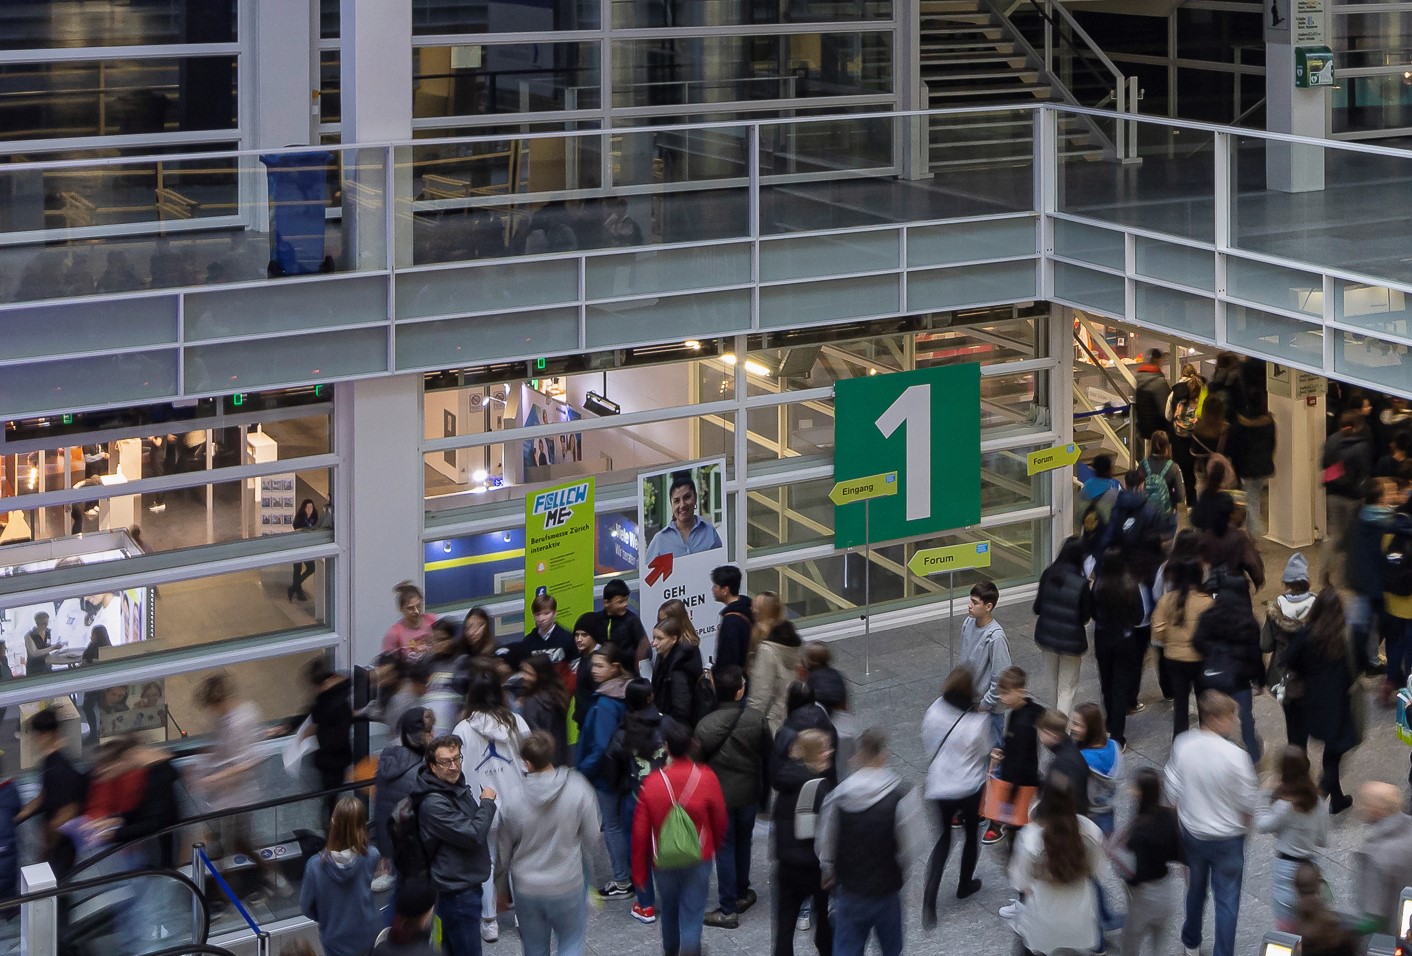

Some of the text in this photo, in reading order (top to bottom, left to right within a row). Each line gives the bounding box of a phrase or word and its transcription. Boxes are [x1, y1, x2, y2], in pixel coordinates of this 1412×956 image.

[874, 384, 931, 521] 1
[1033, 453, 1054, 466] Forum
[842, 482, 874, 497] Eingang
[533, 483, 588, 514] FOLLOW
[545, 506, 573, 528] ME
[531, 523, 590, 545] Berufsmesse Zürich
[531, 541, 561, 554] interaktiv
[923, 553, 954, 567] Forum
[663, 585, 686, 600] GEH
